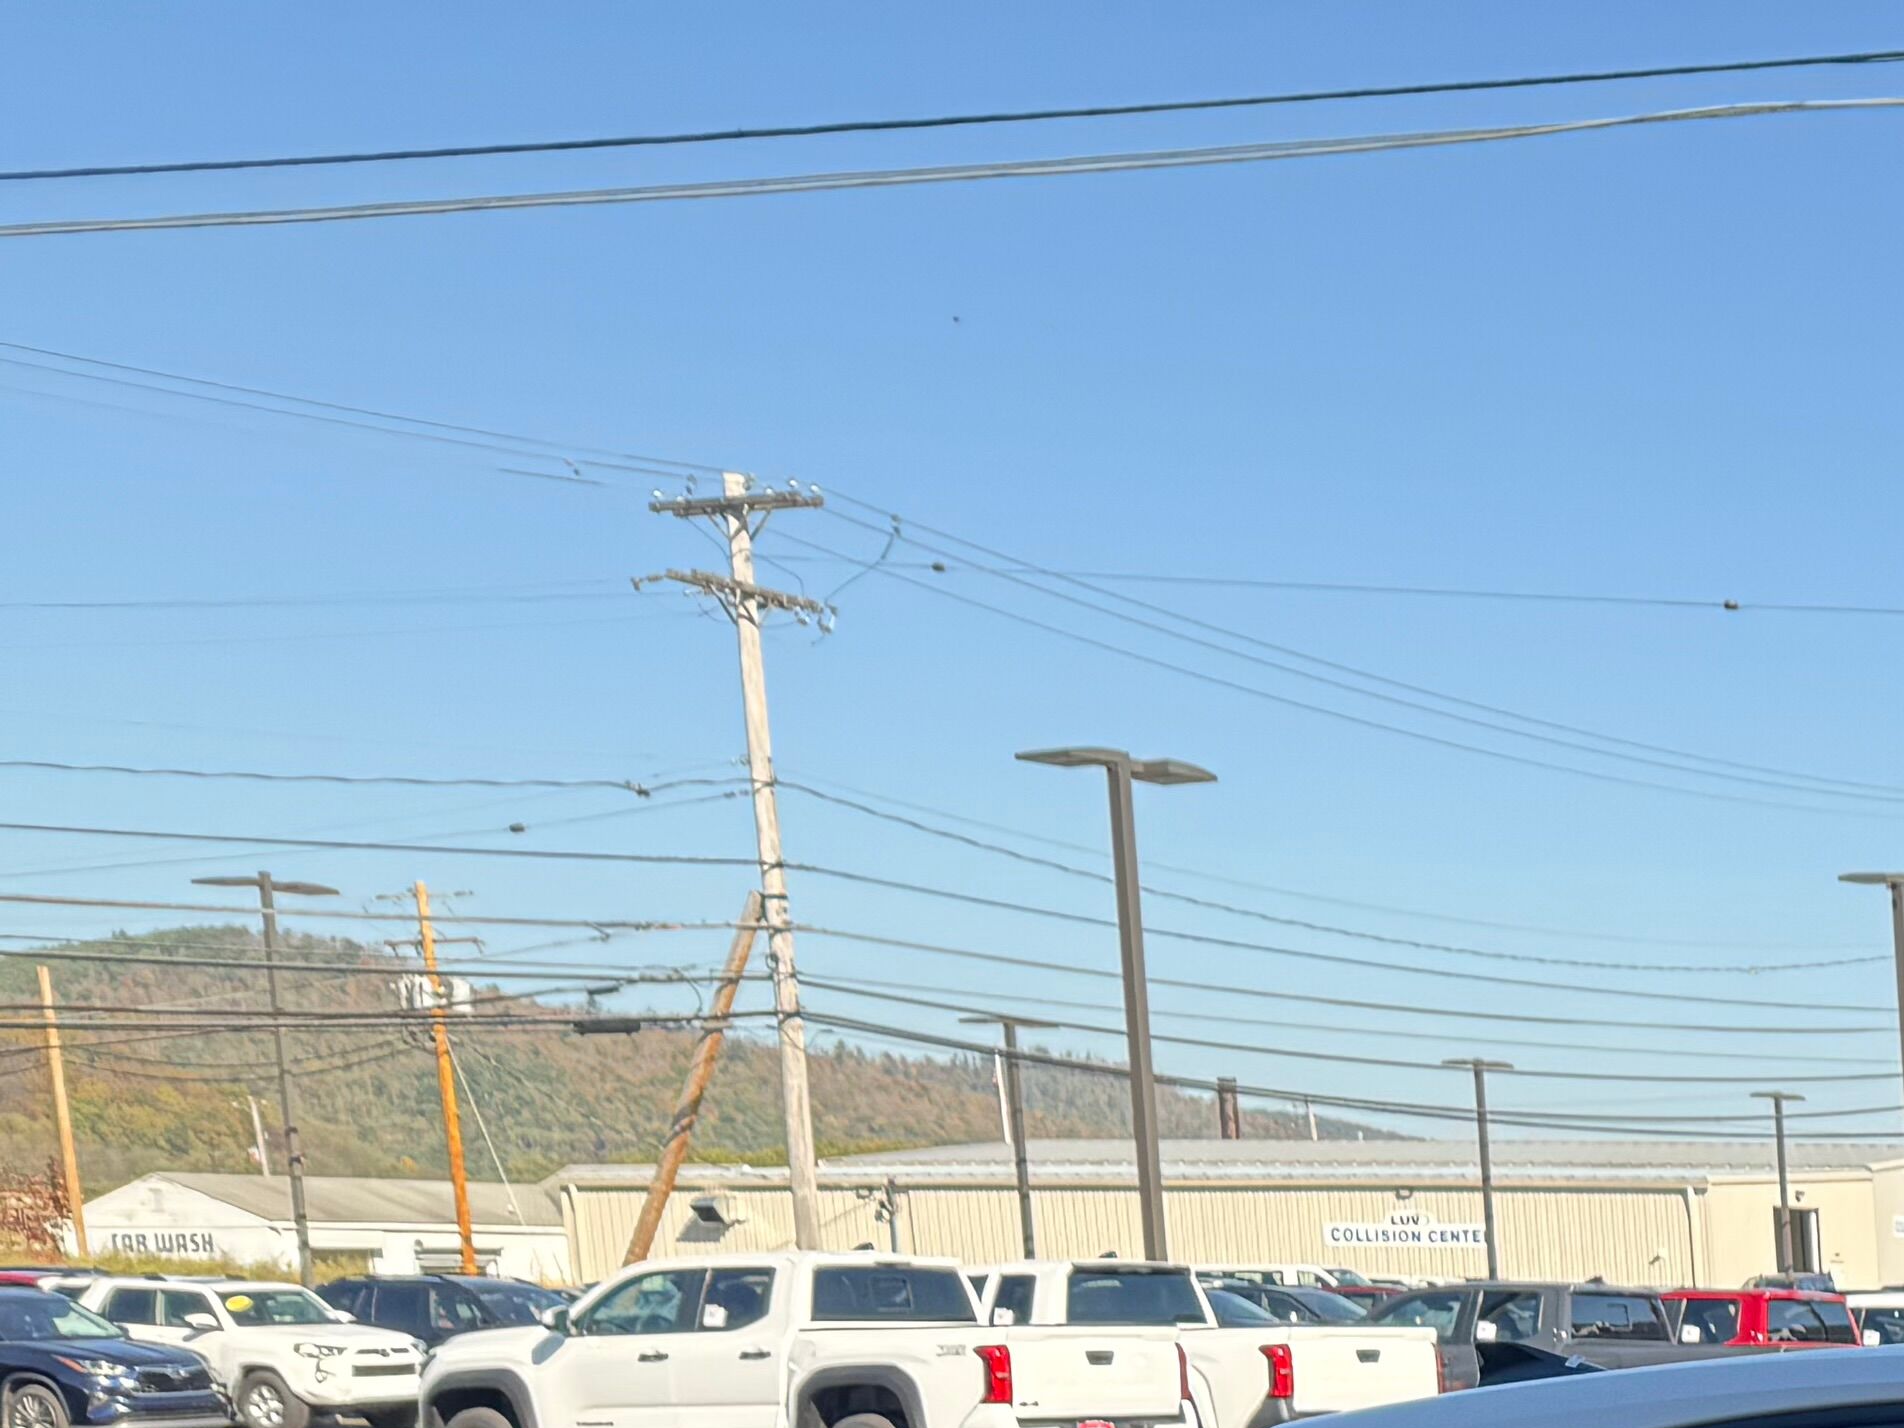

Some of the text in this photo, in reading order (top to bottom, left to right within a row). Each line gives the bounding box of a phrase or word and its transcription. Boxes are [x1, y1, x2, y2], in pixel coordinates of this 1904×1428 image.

[111, 1232, 214, 1253] CAR WASH
[1330, 1227, 1486, 1244] COLLISION CENTE
